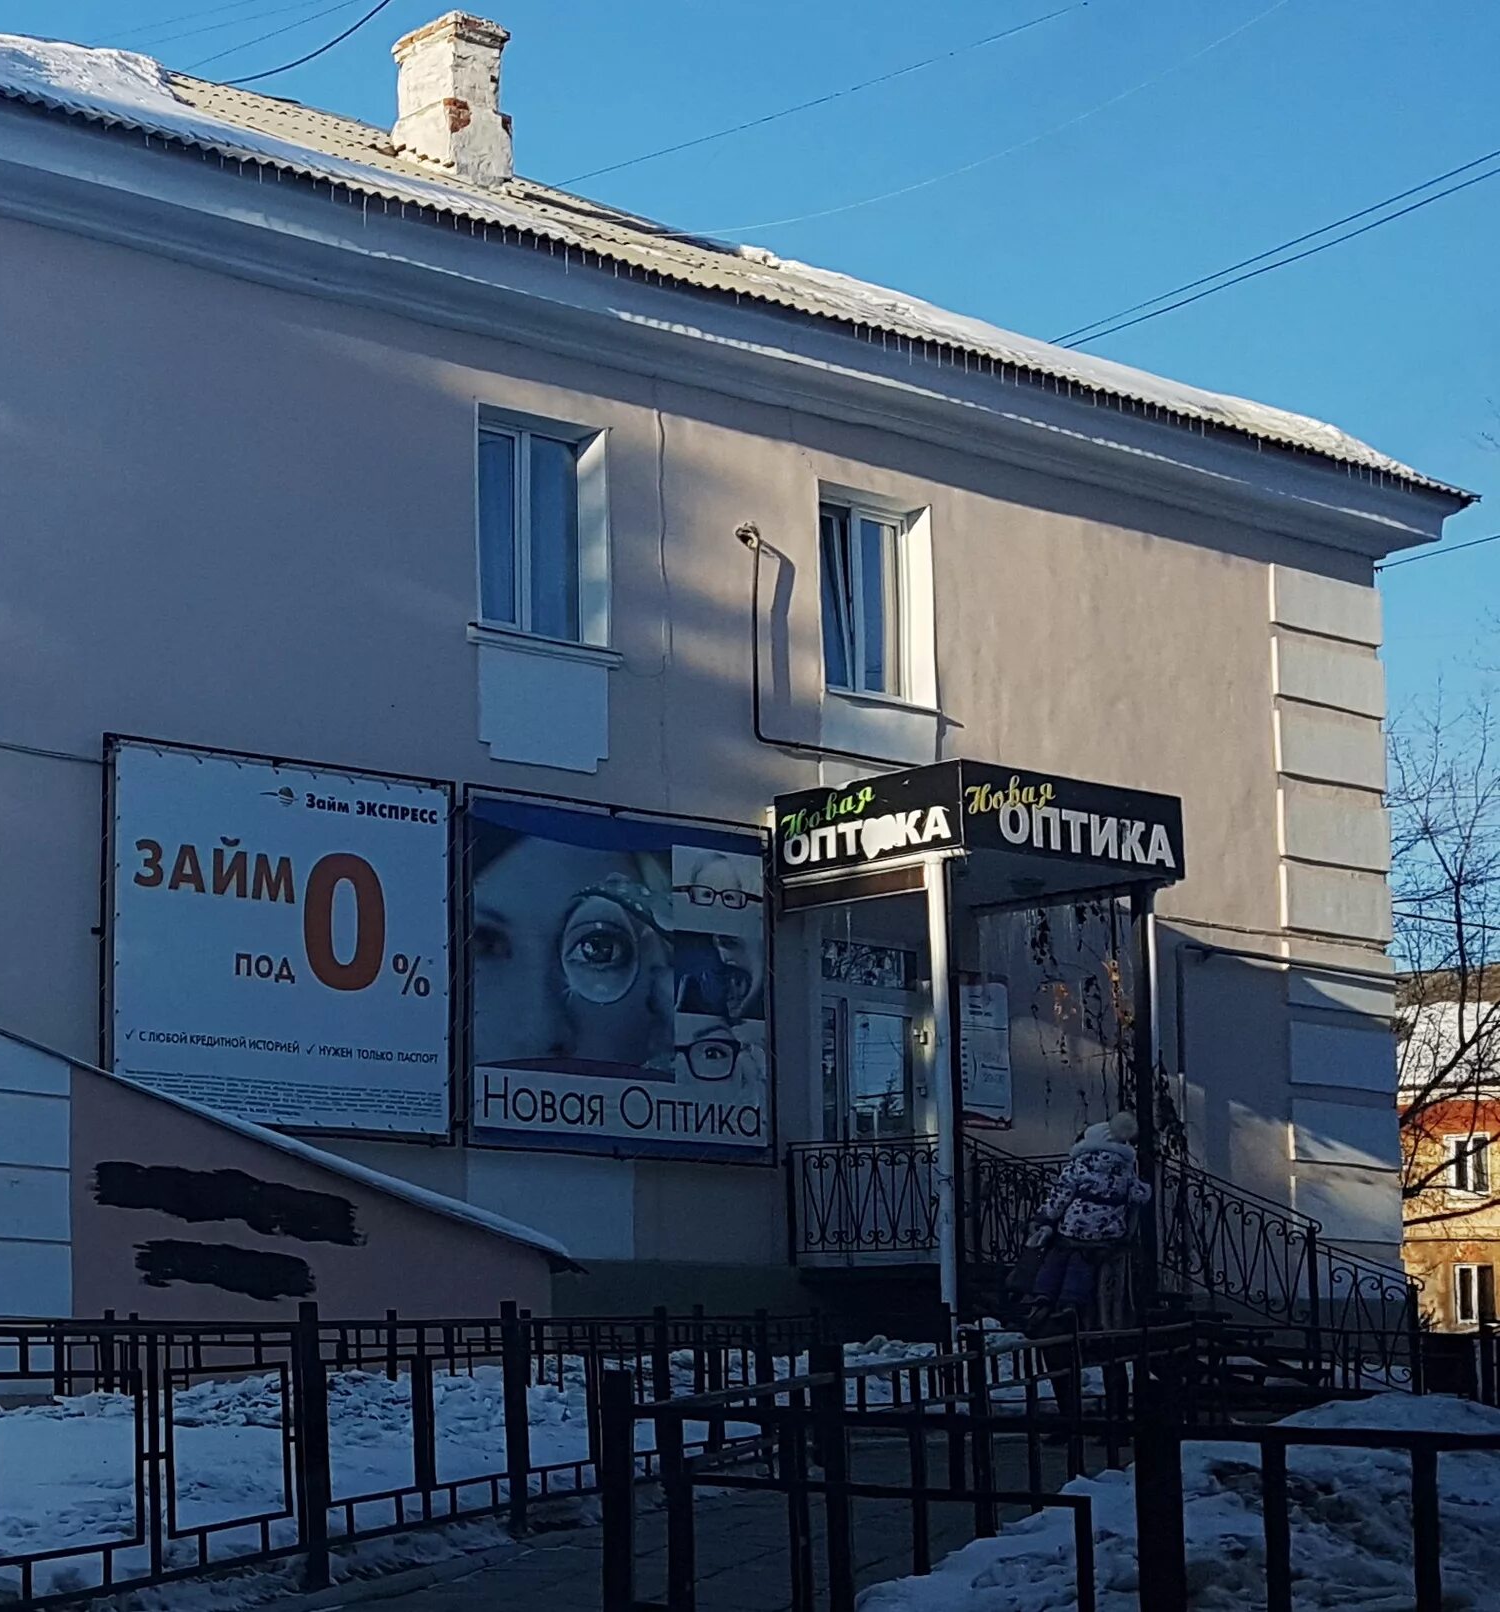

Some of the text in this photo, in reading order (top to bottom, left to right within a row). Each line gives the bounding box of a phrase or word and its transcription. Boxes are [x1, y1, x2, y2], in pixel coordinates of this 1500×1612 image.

[306, 793, 437, 824] Займ ЭКСПРЕСС
[781, 786, 875, 838] Новая
[964, 775, 1056, 814] Новая
[784, 806, 951, 865] ОПТКА
[1000, 801, 1176, 868] ОПТИКА
[134, 836, 295, 904] ЗАЙМ
[235, 953, 295, 983] ПОД
[139, 1031, 438, 1064] С ЛЮБОЙ КРЕДИТНОЙ ИСТОРИЕЙ НУЖЕН ТОЛЬКО ПАСПОРТ
[483, 1075, 604, 1126] Новая
[619, 1086, 761, 1137] Оптика
